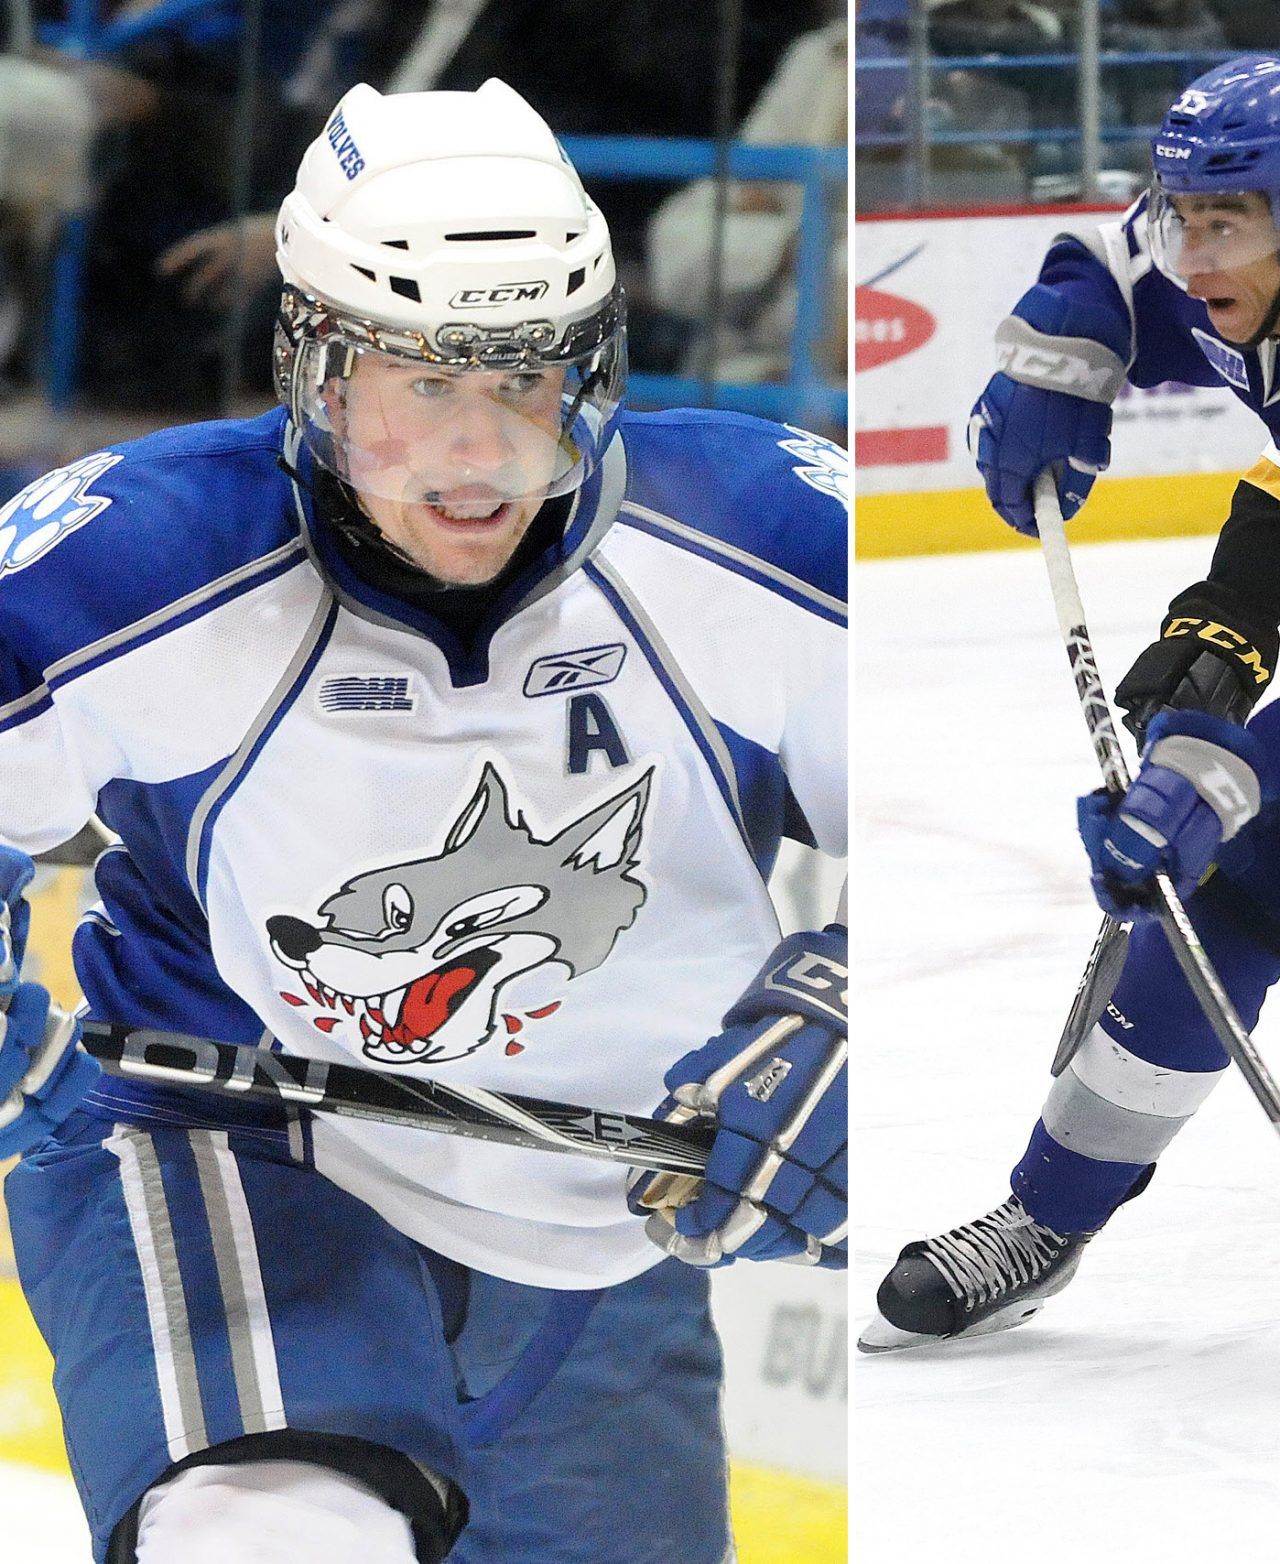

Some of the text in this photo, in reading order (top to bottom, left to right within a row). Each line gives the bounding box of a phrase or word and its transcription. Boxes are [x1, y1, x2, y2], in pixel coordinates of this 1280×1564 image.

[327, 106, 365, 181] WOLVES
[1155, 144, 1192, 160] CCM
[459, 286, 544, 303] CCM
[1163, 617, 1271, 685] CCM
[567, 692, 630, 775] A
[82, 1021, 331, 1104] ON
